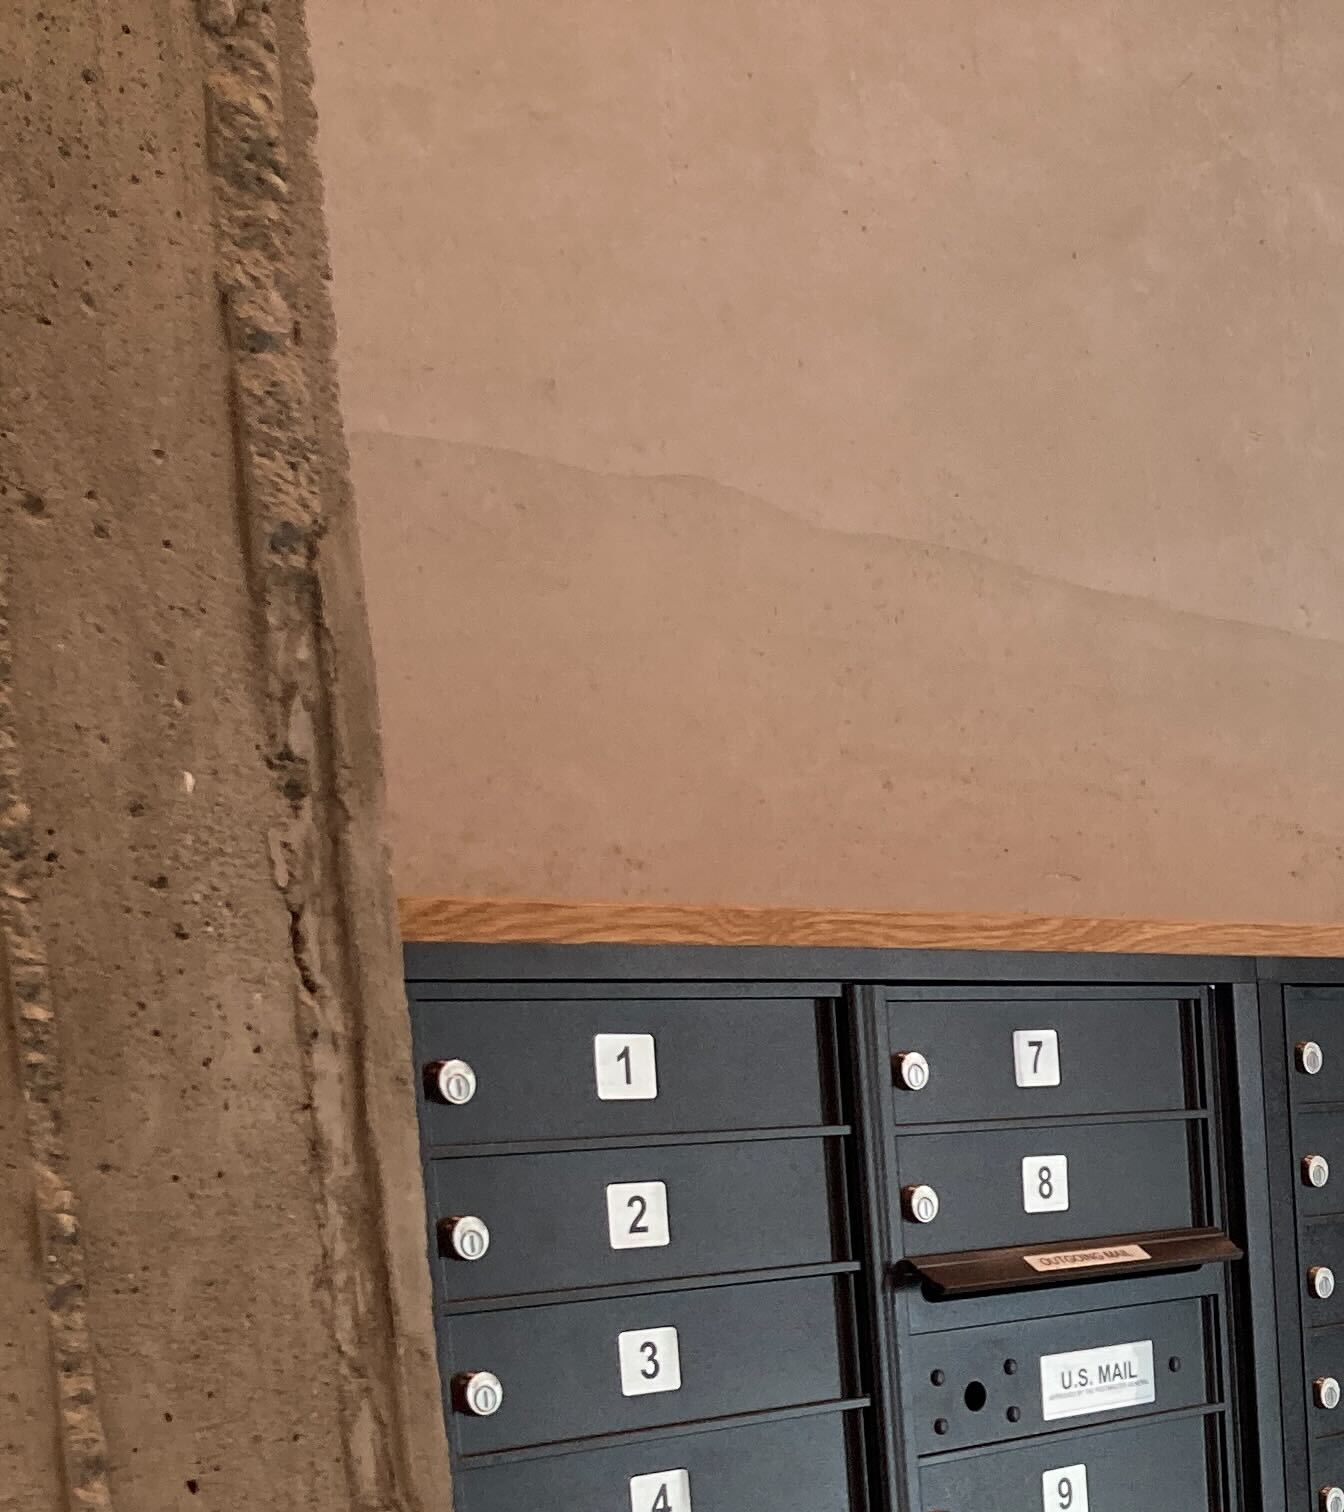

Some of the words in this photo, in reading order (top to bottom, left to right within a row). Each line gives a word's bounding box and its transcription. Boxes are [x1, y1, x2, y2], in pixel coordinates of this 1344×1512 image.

[616, 1046, 632, 1085] 1
[1027, 1040, 1043, 1074] 7
[1038, 1166, 1053, 1200] 8
[627, 1195, 649, 1234] 2
[1039, 1251, 1105, 1267] OUTGOING
[1104, 1248, 1134, 1260] MAIL
[639, 1341, 660, 1380] 3
[1061, 1368, 1093, 1390] U.S.
[1098, 1361, 1138, 1385] MAIL
[1057, 1477, 1073, 1510] 9
